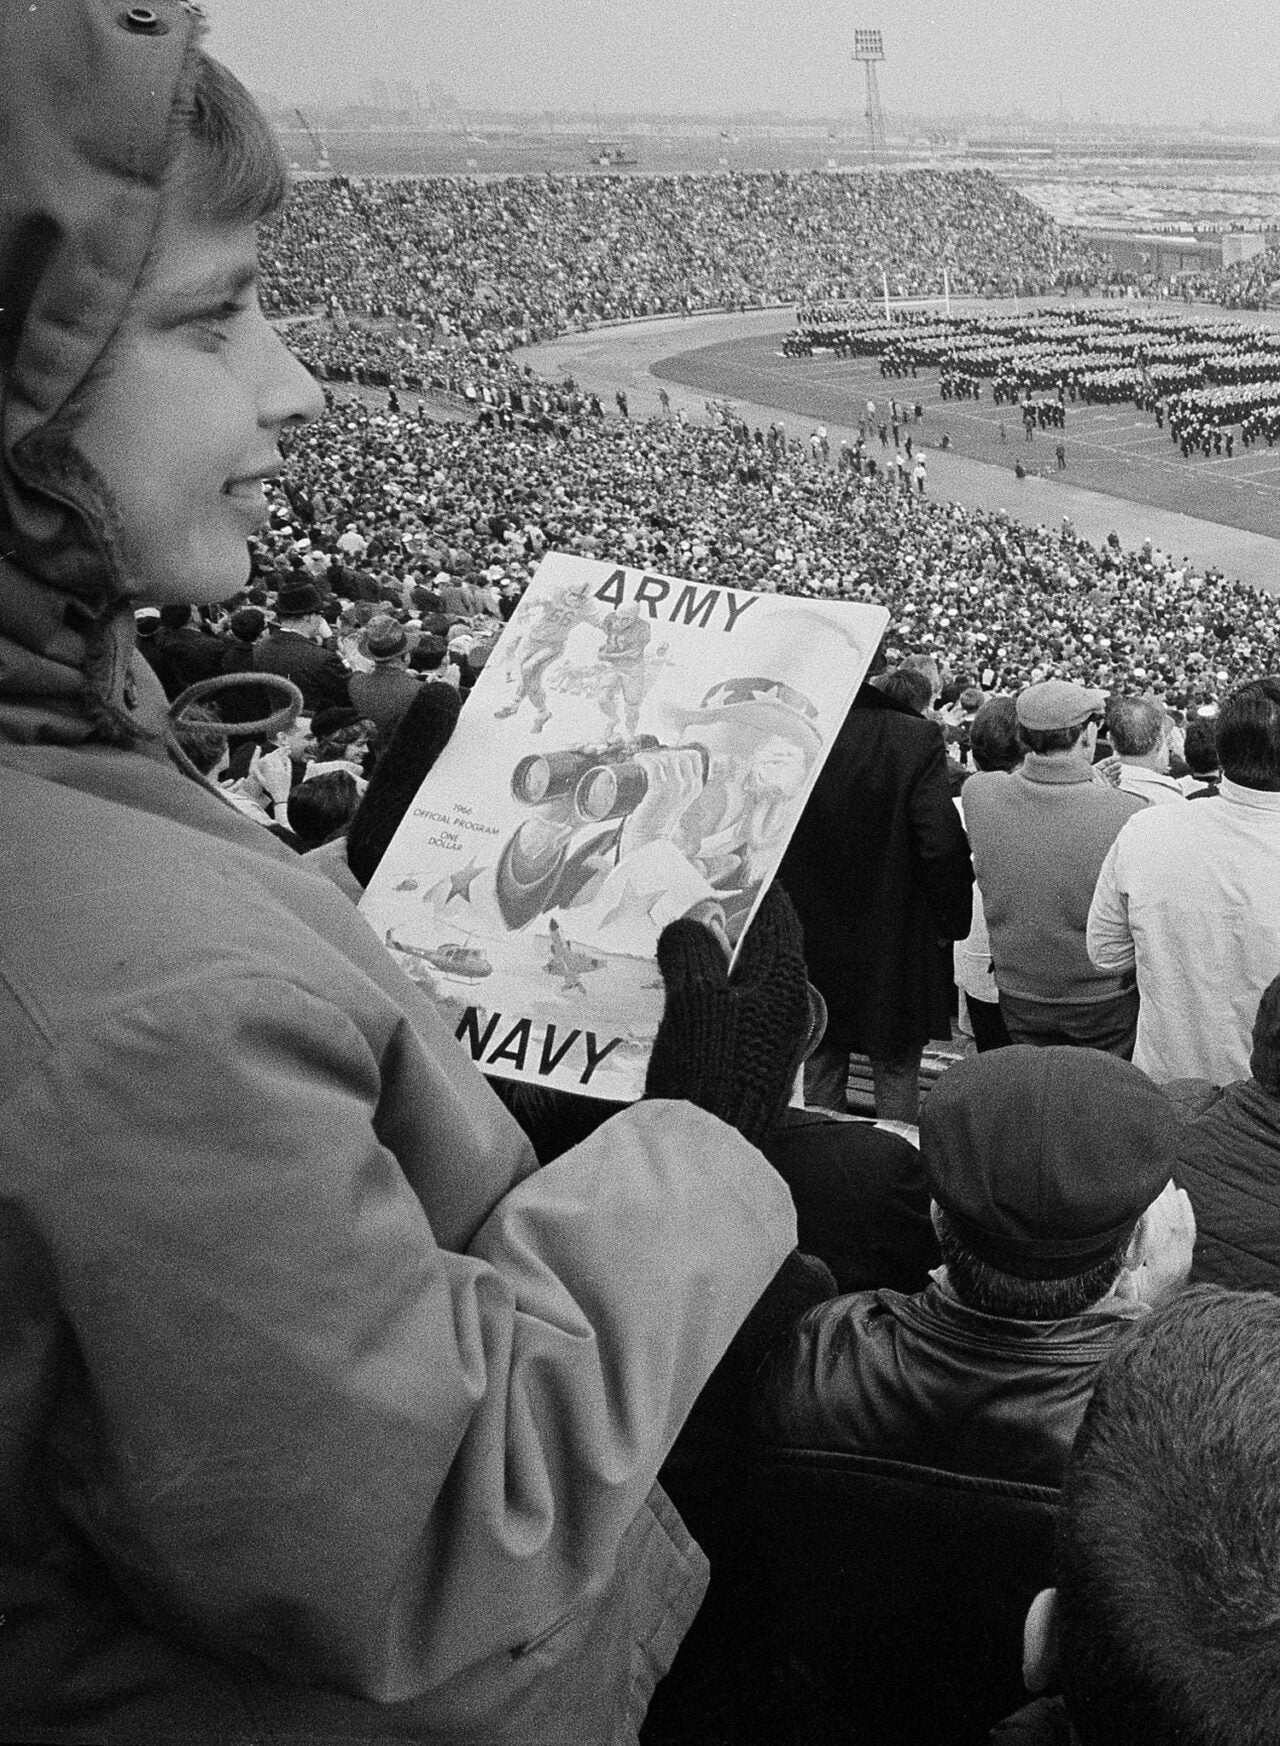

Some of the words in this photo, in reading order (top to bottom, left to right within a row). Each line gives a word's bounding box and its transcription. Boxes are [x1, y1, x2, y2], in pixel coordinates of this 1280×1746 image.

[594, 569, 760, 632] ARMY
[453, 804, 473, 816] 1966
[413, 808, 450, 824] OFFICIAL
[453, 817, 499, 835] PROGRAM
[428, 836, 463, 851] DOLLAR
[440, 831, 459, 842] ONE
[454, 1005, 623, 1085] NAVY
